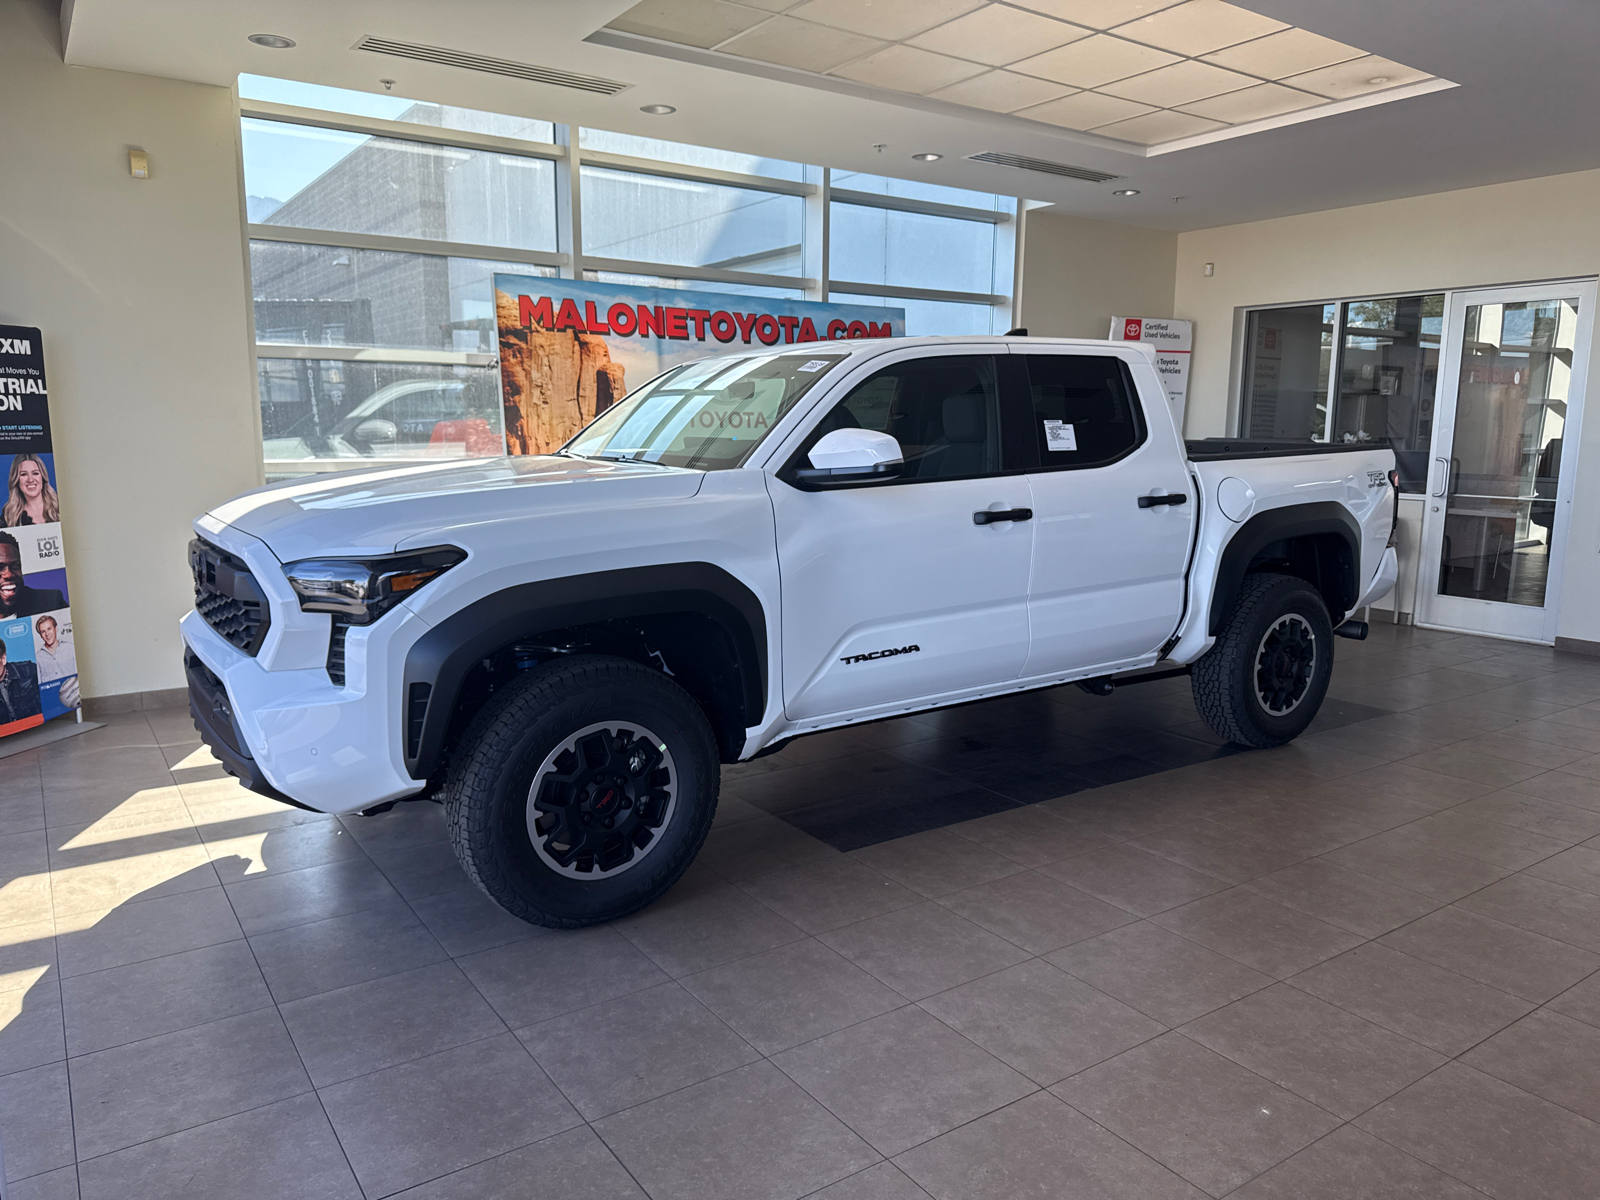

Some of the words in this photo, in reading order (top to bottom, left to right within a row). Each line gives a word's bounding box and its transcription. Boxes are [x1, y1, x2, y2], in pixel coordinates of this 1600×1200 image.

[518, 294, 892, 346] MALONETOYOTA.COM
[1145, 323, 1168, 331] Certified
[1159, 332, 1180, 340] Vehicles
[1160, 358, 1179, 366] Toyota
[6, 367, 27, 375] Moves
[0, 378, 48, 394] TRIAL
[38, 540, 59, 552] LOL
[39, 550, 60, 559] RADIO
[840, 644, 921, 665] TACOMA
[596, 789, 614, 809] TRD
